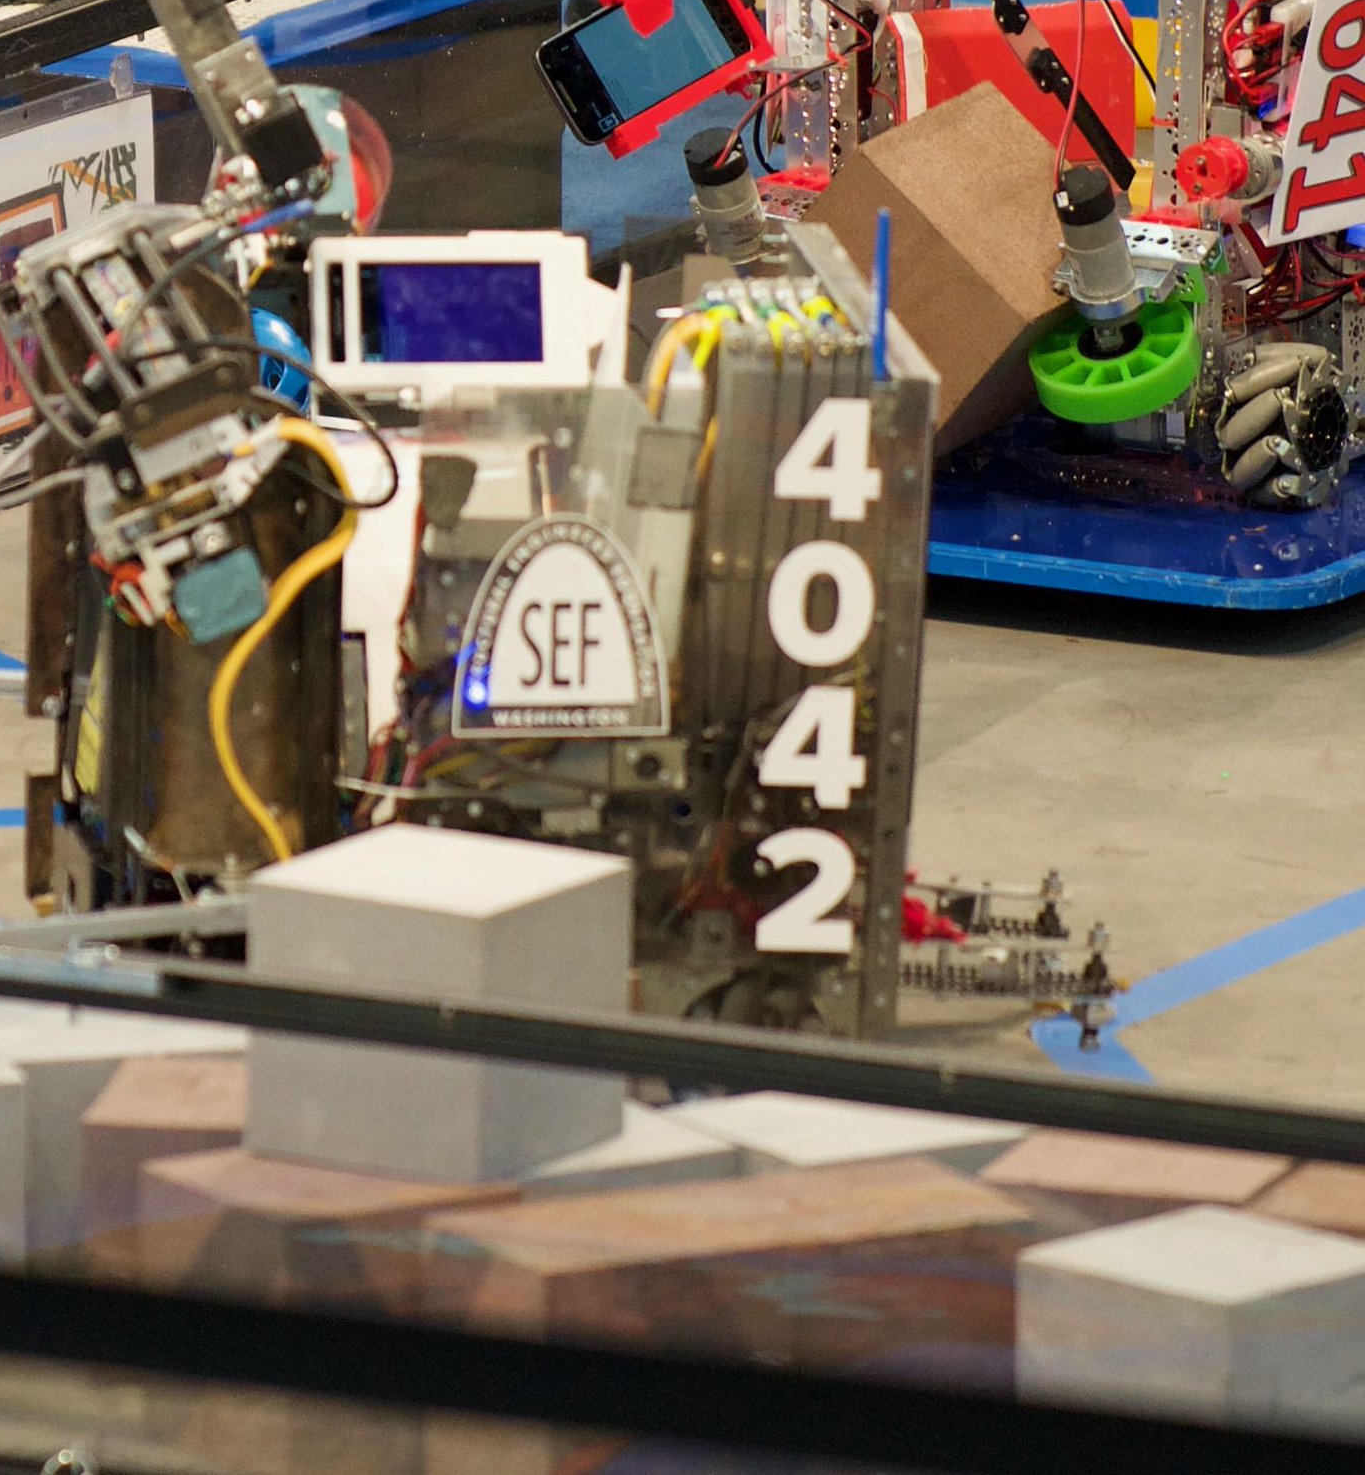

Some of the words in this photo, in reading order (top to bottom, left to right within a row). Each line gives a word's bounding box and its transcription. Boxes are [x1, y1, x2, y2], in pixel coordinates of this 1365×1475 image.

[519, 601, 602, 689] SEF
[755, 398, 882, 953] 4042
[491, 707, 630, 727] WASHINGTON
